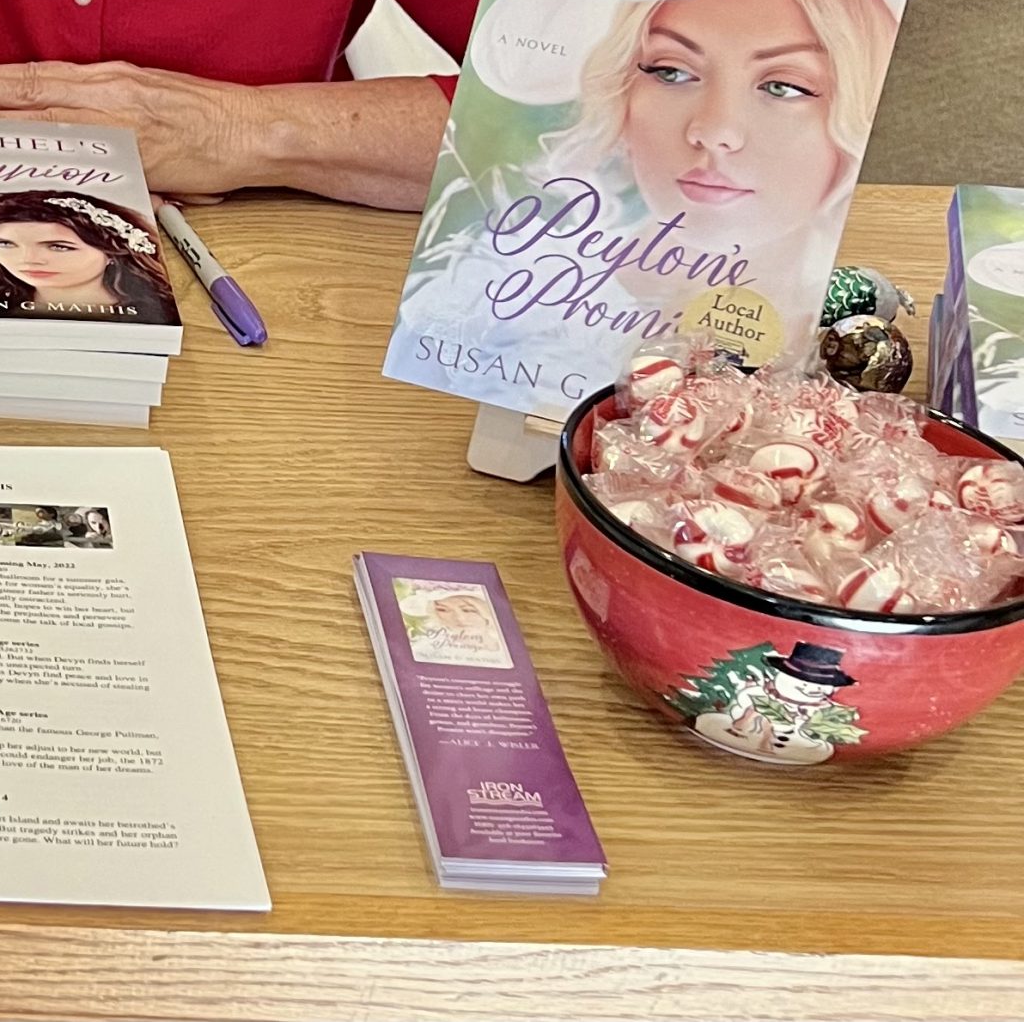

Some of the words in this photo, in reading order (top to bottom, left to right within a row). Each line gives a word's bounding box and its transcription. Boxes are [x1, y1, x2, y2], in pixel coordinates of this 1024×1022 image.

[498, 35, 508, 44] A
[516, 36, 568, 56] NOVEL
[485, 177, 759, 292] Peyton's
[20, 300, 36, 313] G
[47, 300, 139, 316] MATHIS
[485, 253, 682, 341] Promi
[711, 294, 765, 323] Local
[697, 311, 766, 343] Author
[415, 334, 543, 390] SUSAN
[560, 372, 588, 401] G
